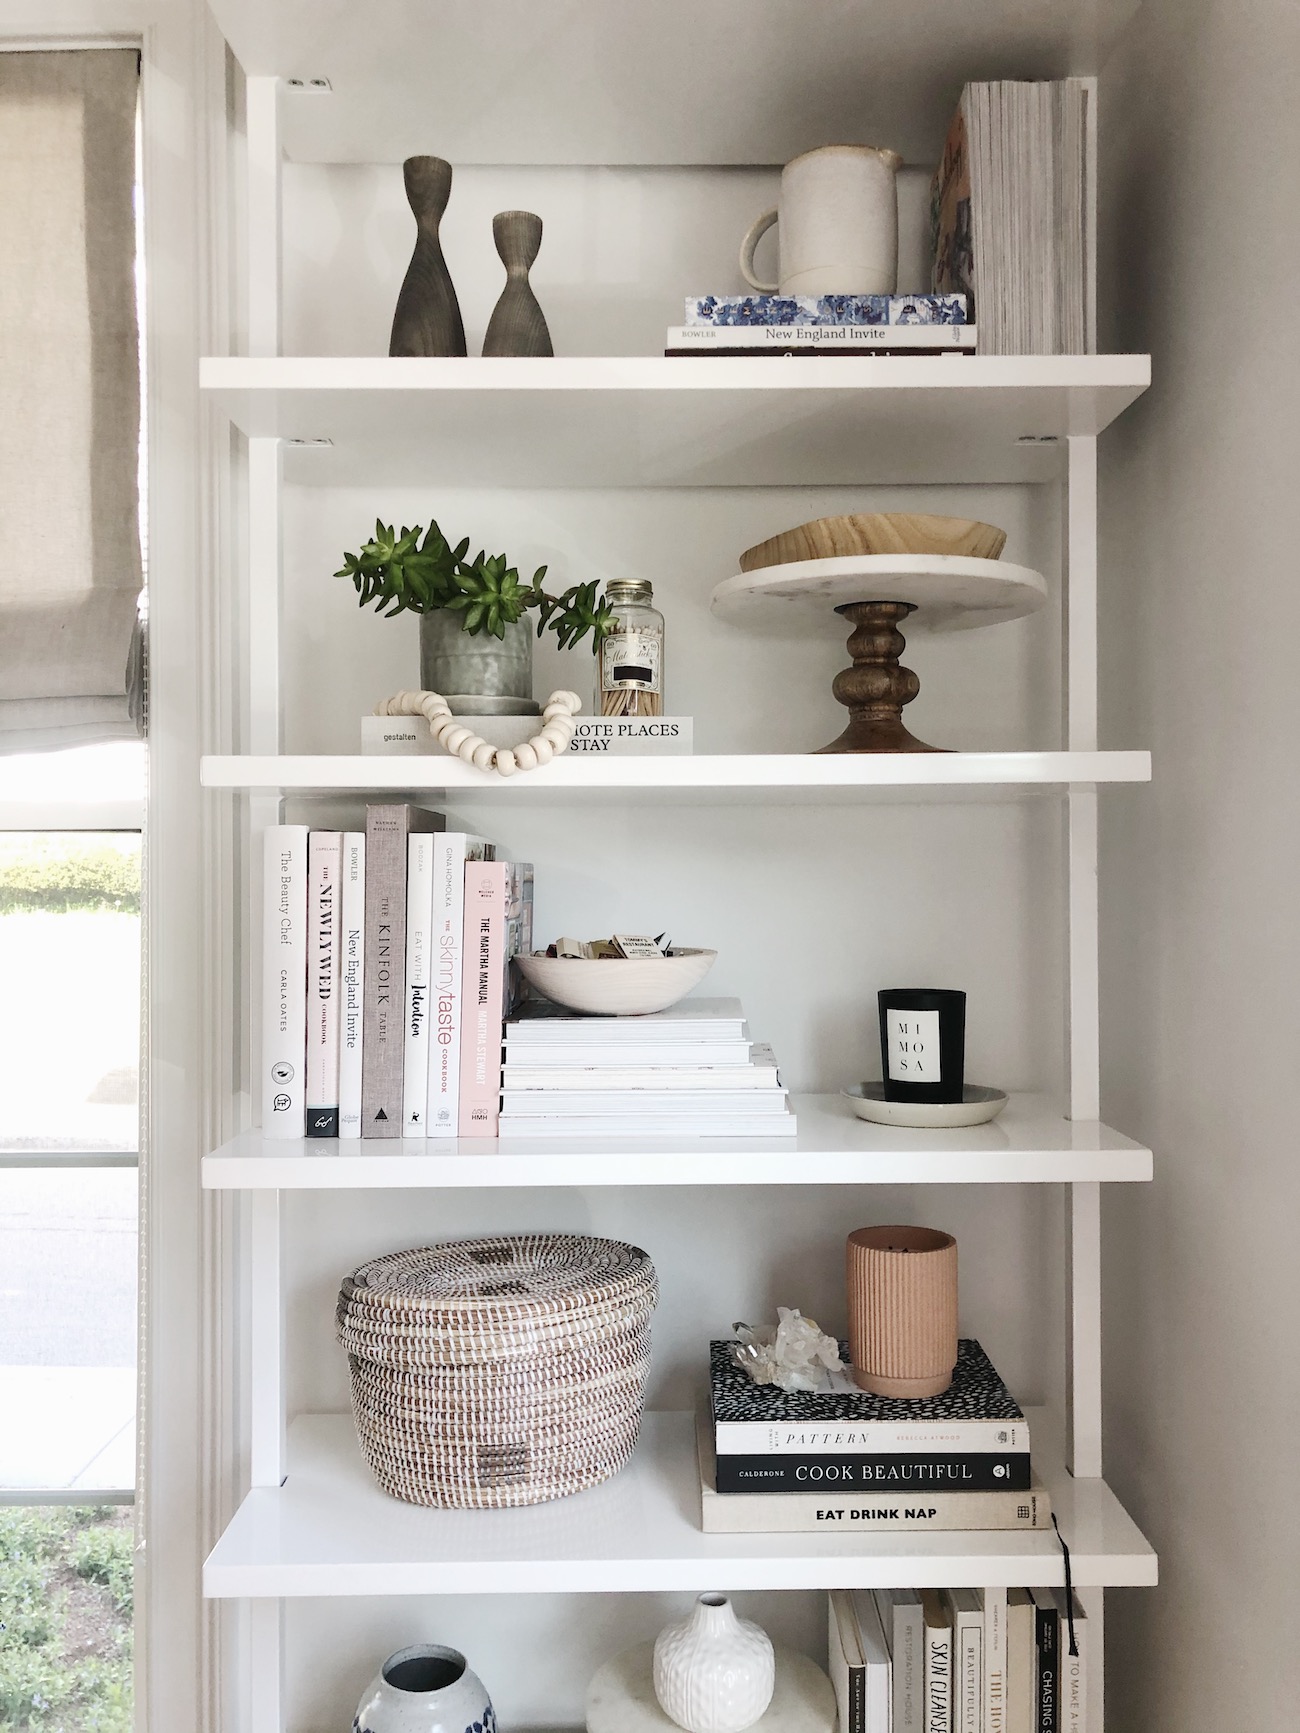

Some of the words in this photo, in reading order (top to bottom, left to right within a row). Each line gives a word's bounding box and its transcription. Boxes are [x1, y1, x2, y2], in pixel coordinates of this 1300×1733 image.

[766, 328, 792, 339] New
[797, 328, 846, 342] England
[850, 328, 885, 339] Invite
[384, 734, 416, 742] gestalten
[618, 724, 679, 736] PLACES
[570, 740, 610, 751] STAY
[280, 850, 292, 872] The
[350, 848, 358, 881] BOWLER
[279, 876, 292, 914] Beauty
[281, 918, 292, 945] Chef
[480, 918, 490, 933] THE
[319, 884, 331, 1000] NEWLYWED
[348, 930, 360, 956] New
[414, 931, 422, 949] EAT
[479, 936, 489, 969] MARTHA
[378, 925, 390, 1005] KINFOLK
[414, 954, 422, 981] WITH
[344, 960, 359, 1009] England
[478, 972, 488, 1005] MANUAL
[411, 984, 426, 1038] Intention
[347, 1013, 358, 1048] Invite
[477, 1011, 486, 1044] MARTHA
[476, 1047, 486, 1085] STEWART
[786, 1433, 869, 1444] PATTERN
[739, 1470, 784, 1478] CALDERONE
[796, 1465, 853, 1480] COOK
[862, 1464, 972, 1480] BEAUTIFUL
[816, 1509, 844, 1520] EAT
[850, 1509, 899, 1519] DRINK
[905, 1508, 937, 1519] NAP
[931, 1642, 948, 1676] SKIN
[1070, 1662, 1079, 1676] TO
[990, 1670, 1001, 1703] THE
[1042, 1670, 1053, 1726] CHASING
[1070, 1680, 1079, 1709] MAKE
